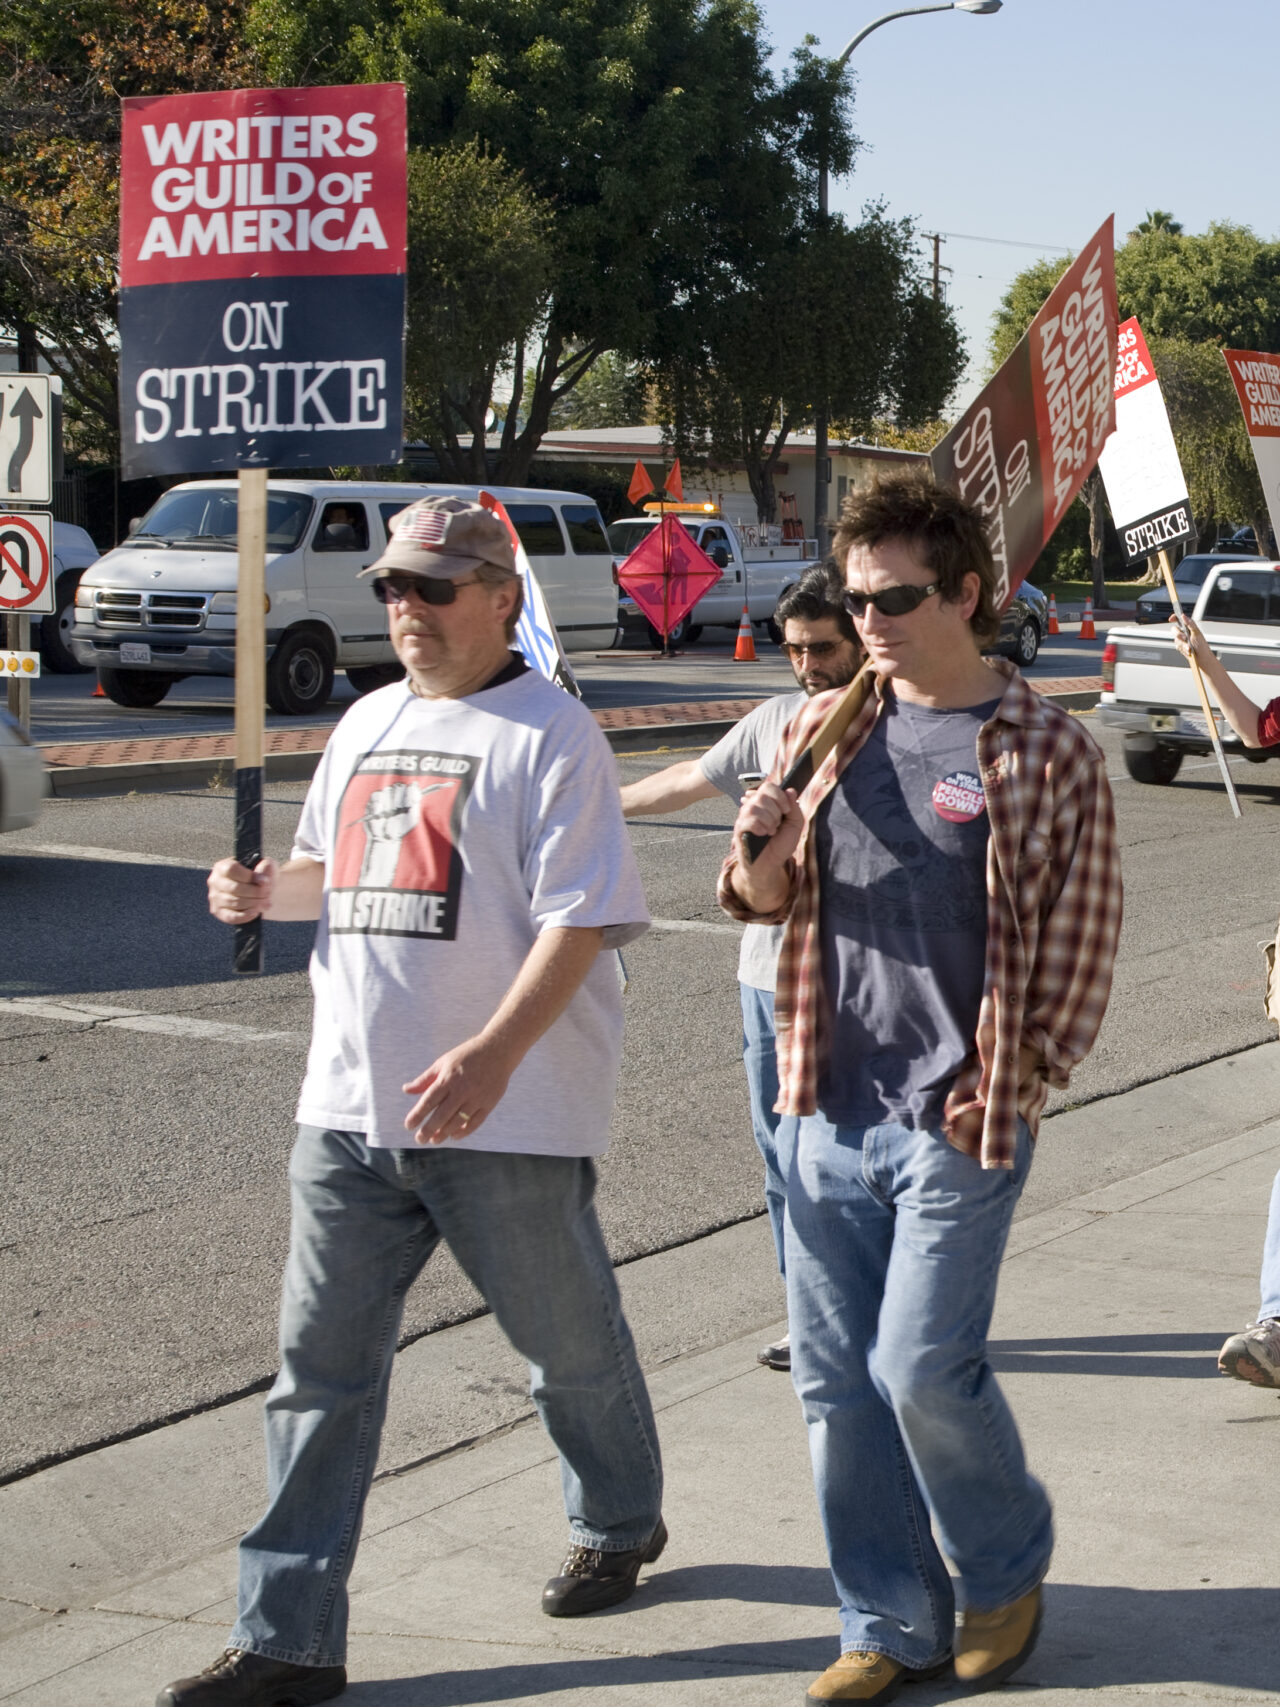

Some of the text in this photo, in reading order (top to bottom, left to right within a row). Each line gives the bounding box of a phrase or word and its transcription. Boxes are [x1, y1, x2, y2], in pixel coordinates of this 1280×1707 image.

[141, 112, 378, 166] WRITERS
[151, 162, 373, 212] GUILD OF
[137, 207, 389, 261] AMERICA
[222, 301, 289, 352] ON
[1081, 245, 1111, 448] WRITERS
[1061, 291, 1091, 471] GUILD OF
[1113, 360, 1149, 392] RICA
[1125, 349, 1139, 366] OF
[135, 358, 387, 444] STRIKE
[1040, 313, 1073, 519] AMERICA
[1245, 382, 1280, 406] GUILD
[1004, 439, 1031, 508] ON
[1124, 507, 1190, 557] STRIKE
[420, 756, 471, 774] GUILD
[945, 777, 984, 794] ON STRIKE
[956, 772, 979, 786] WGA
[935, 792, 980, 815] DOWN
[938, 782, 984, 805] PENCILS
[353, 890, 447, 934] STRIKE
